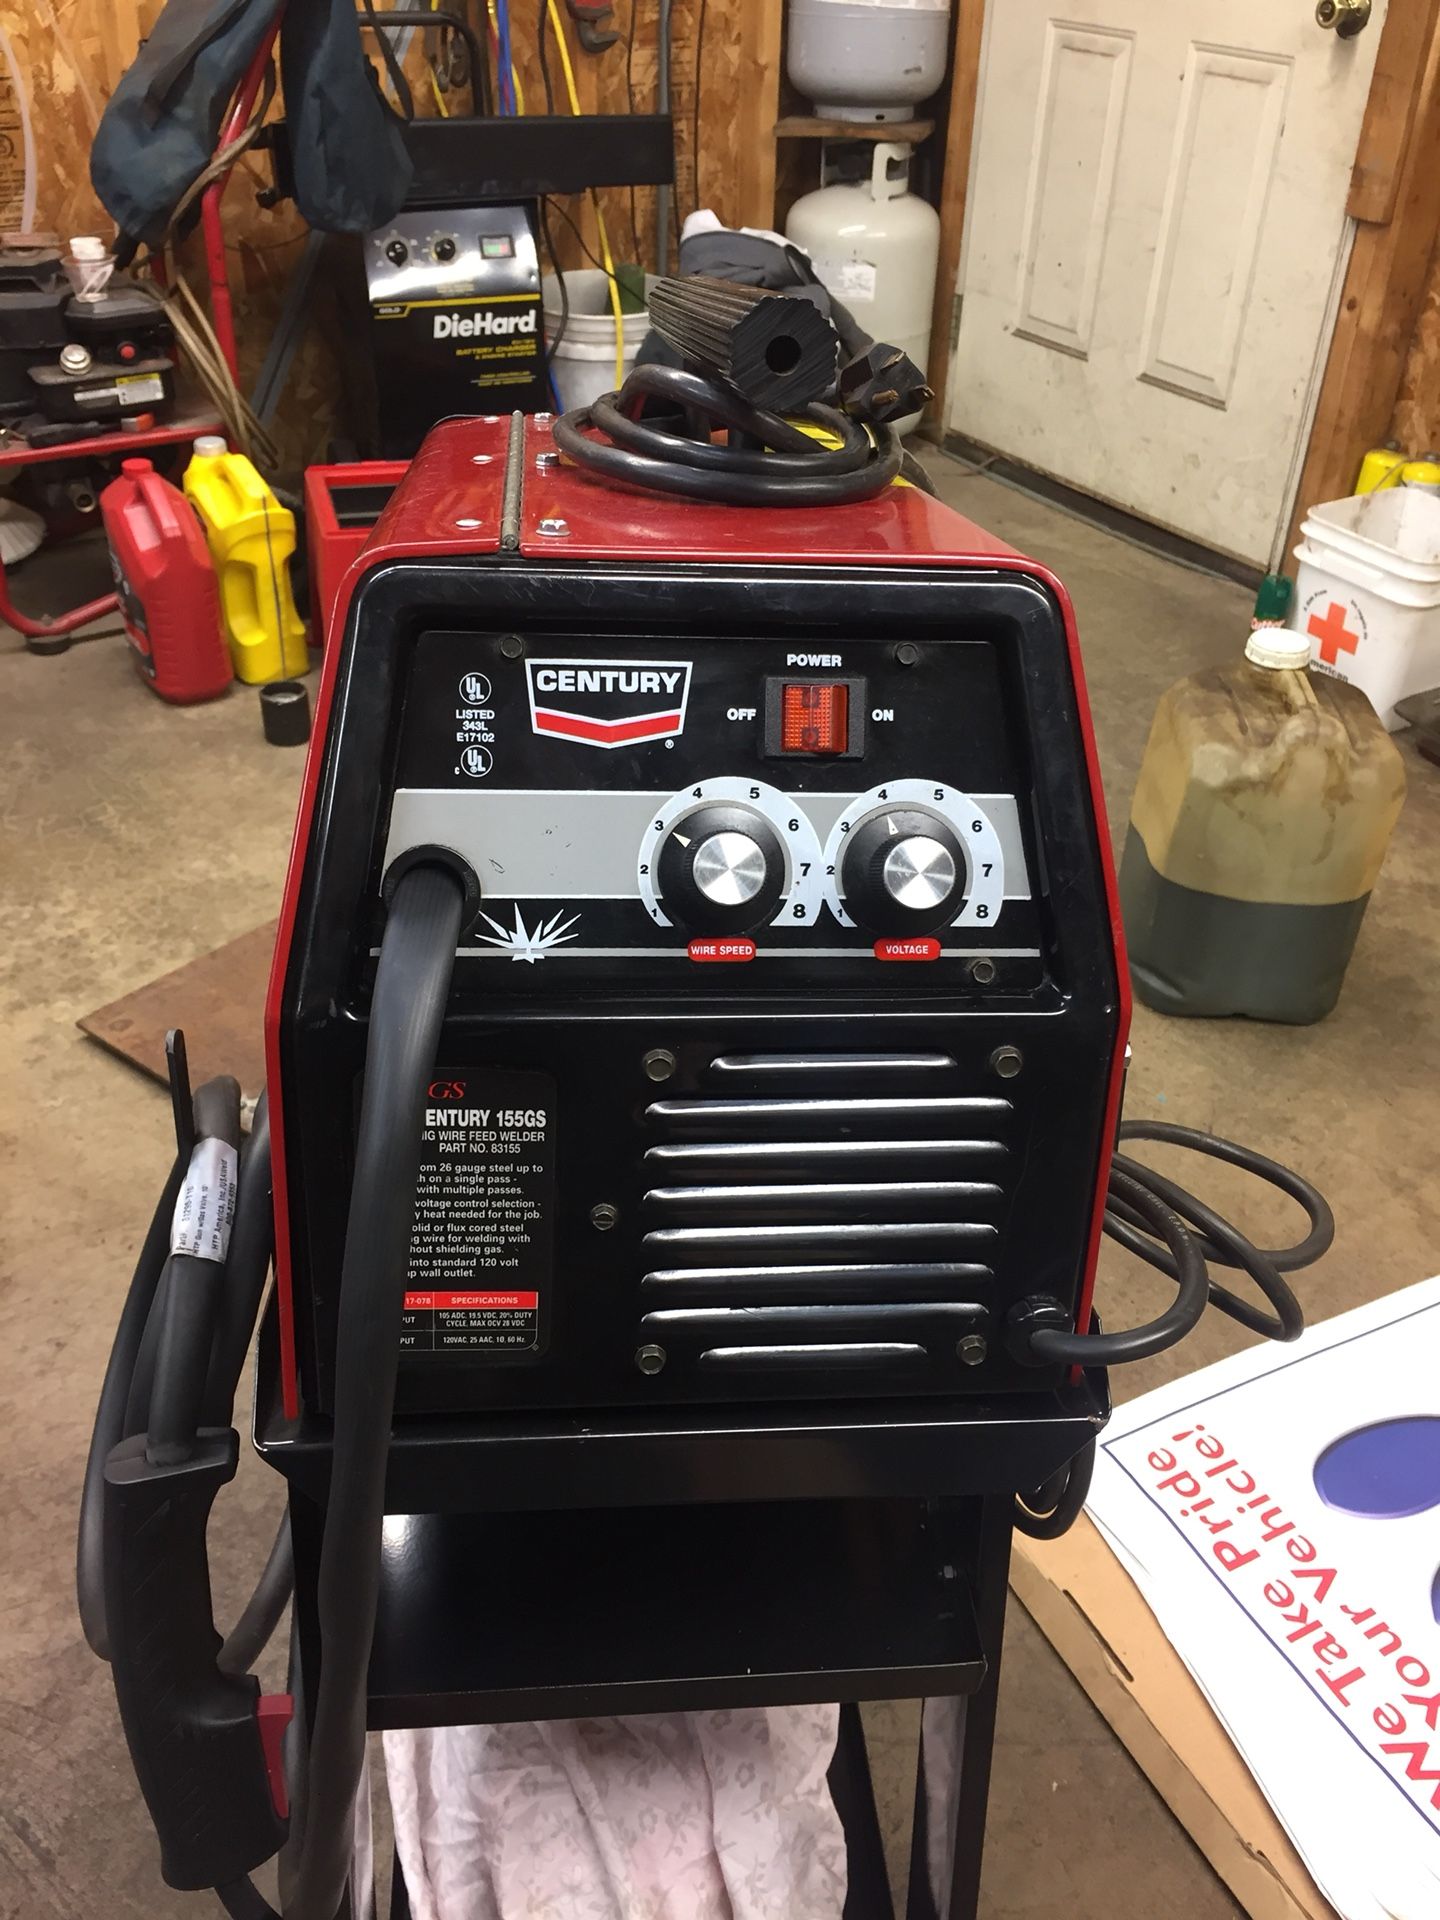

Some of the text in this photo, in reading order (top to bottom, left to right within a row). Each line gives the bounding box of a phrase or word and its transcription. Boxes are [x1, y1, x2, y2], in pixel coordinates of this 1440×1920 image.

[433, 309, 537, 339] DieHard
[786, 654, 842, 667] POWER
[1310, 659, 1349, 683] merican
[536, 670, 682, 694] CENTURY
[455, 709, 495, 719] LISTED
[726, 708, 757, 721] OFF
[871, 709, 894, 722] ON
[462, 720, 488, 730] 343L
[456, 732, 494, 742] E17102
[640, 788, 811, 918] 1 2 3 4 5 6 7 8
[826, 789, 993, 918] 1 2 3 4 5 6 7 8
[690, 945, 752, 956] WIRE SPEED
[885, 944, 929, 955] VOLTAGE
[428, 1081, 466, 1100] GS
[425, 1109, 547, 1127] ENTURY 155GS
[438, 1131, 466, 1141] WIRE
[469, 1131, 497, 1141] FEED
[500, 1131, 545, 1142] WELDER
[439, 1143, 521, 1153] PART NO. 83155
[420, 1163, 544, 1174] om 26 gauge steel up to
[454, 1174, 485, 1185] single
[487, 1176, 511, 1185] pass
[416, 1185, 524, 1195] with multiple passes.
[415, 1199, 451, 1209] voltage
[453, 1199, 489, 1208] control
[491, 1199, 535, 1208] selection
[423, 1210, 446, 1219] heat
[448, 1210, 485, 1219] needed
[487, 1210, 502, 1219] for
[505, 1210, 521, 1219] the
[523, 1210, 542, 1220] job.
[412, 1223, 430, 1232] olid
[446, 1223, 466, 1232] flux
[468, 1223, 497, 1232] cored
[499, 1223, 524, 1232] steel
[211, 1234, 219, 1250] HTP
[422, 1234, 445, 1243] wire
[447, 1234, 462, 1243] for
[465, 1234, 505, 1244] welding
[507, 1234, 531, 1243] with
[409, 1244, 504, 1255] hout shielding gas.
[409, 1258, 519, 1267] into standard 120 volt
[420, 1269, 441, 1277] wall
[443, 1269, 476, 1277] outlet.
[406, 1297, 518, 1305] 17-078 SPECIFICATIONS
[1171, 1423, 1440, 1731] Your Vehicle!
[1147, 1447, 1440, 1812] We Take Pride
